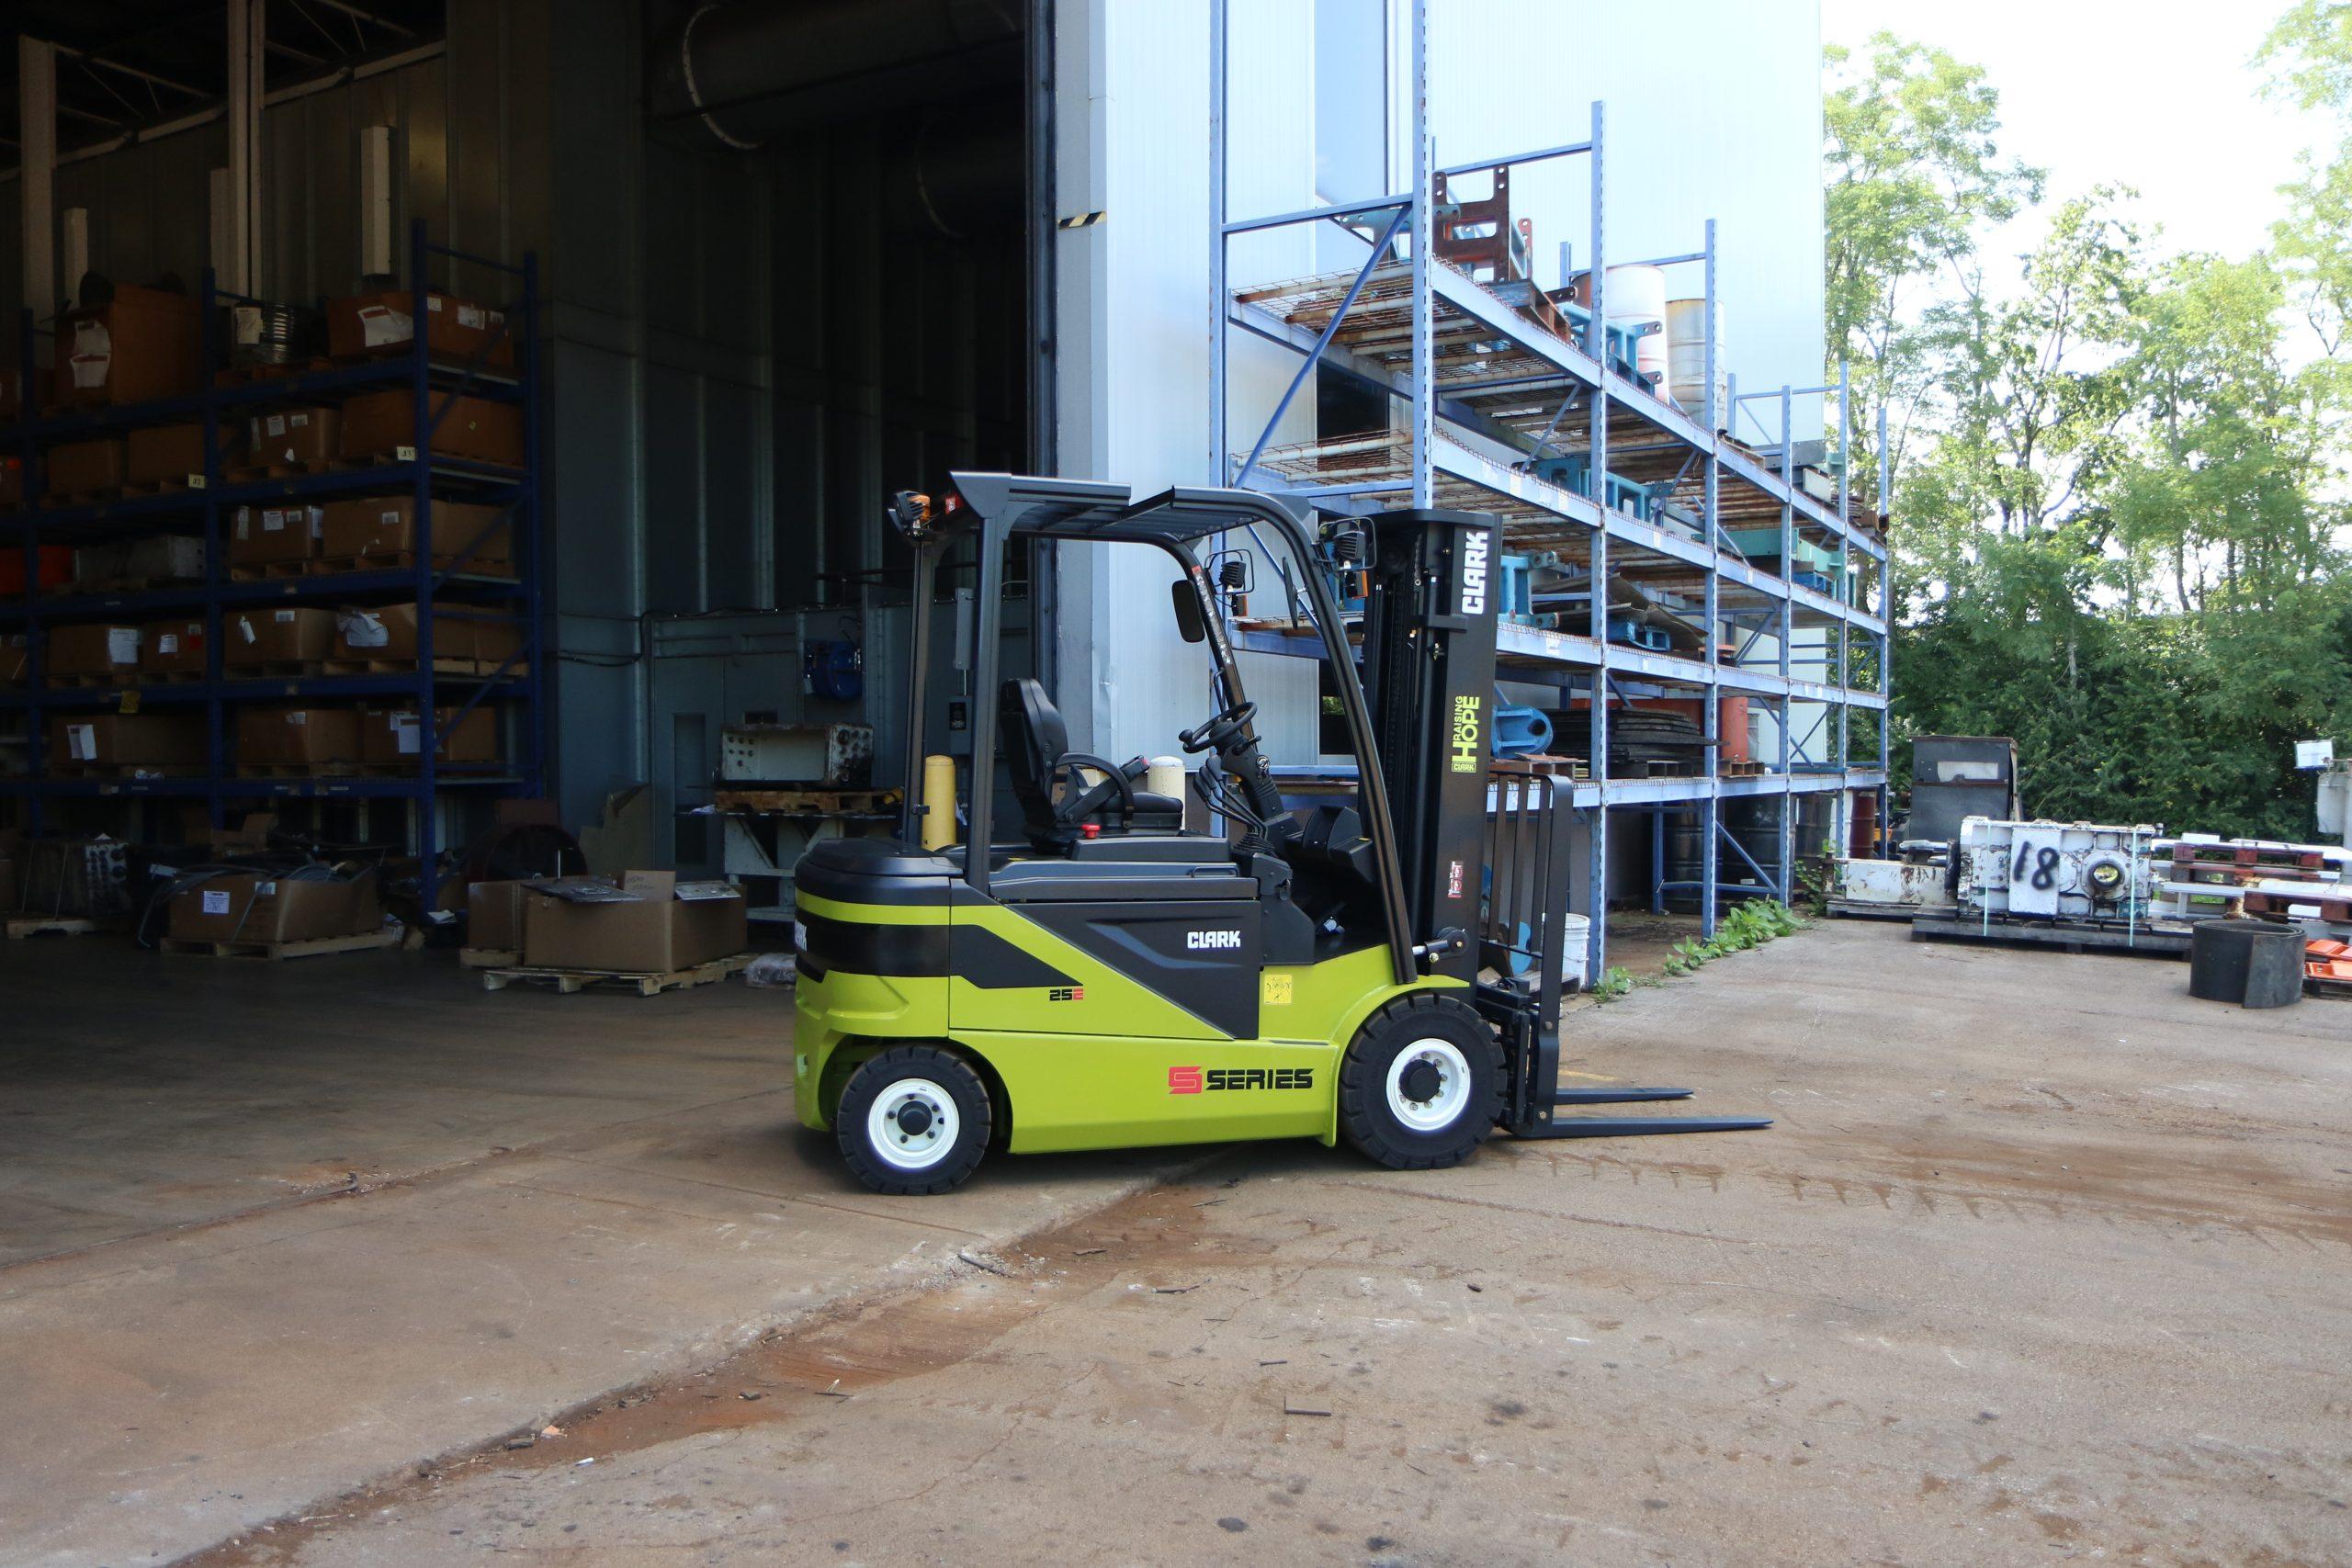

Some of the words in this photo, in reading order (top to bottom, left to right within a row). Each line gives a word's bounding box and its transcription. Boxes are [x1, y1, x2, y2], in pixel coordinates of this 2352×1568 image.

[1462, 532, 1488, 615] CLARK
[1452, 695, 1480, 762] HOPE
[1453, 695, 1464, 741] RAISING
[1453, 763, 1475, 772] CLARK
[2013, 841, 2060, 890] 18
[1187, 931, 1240, 948] CLARK
[1049, 987, 1084, 1001] 25E
[1169, 1066, 1203, 1094] S
[1205, 1068, 1314, 1090] SERIES
